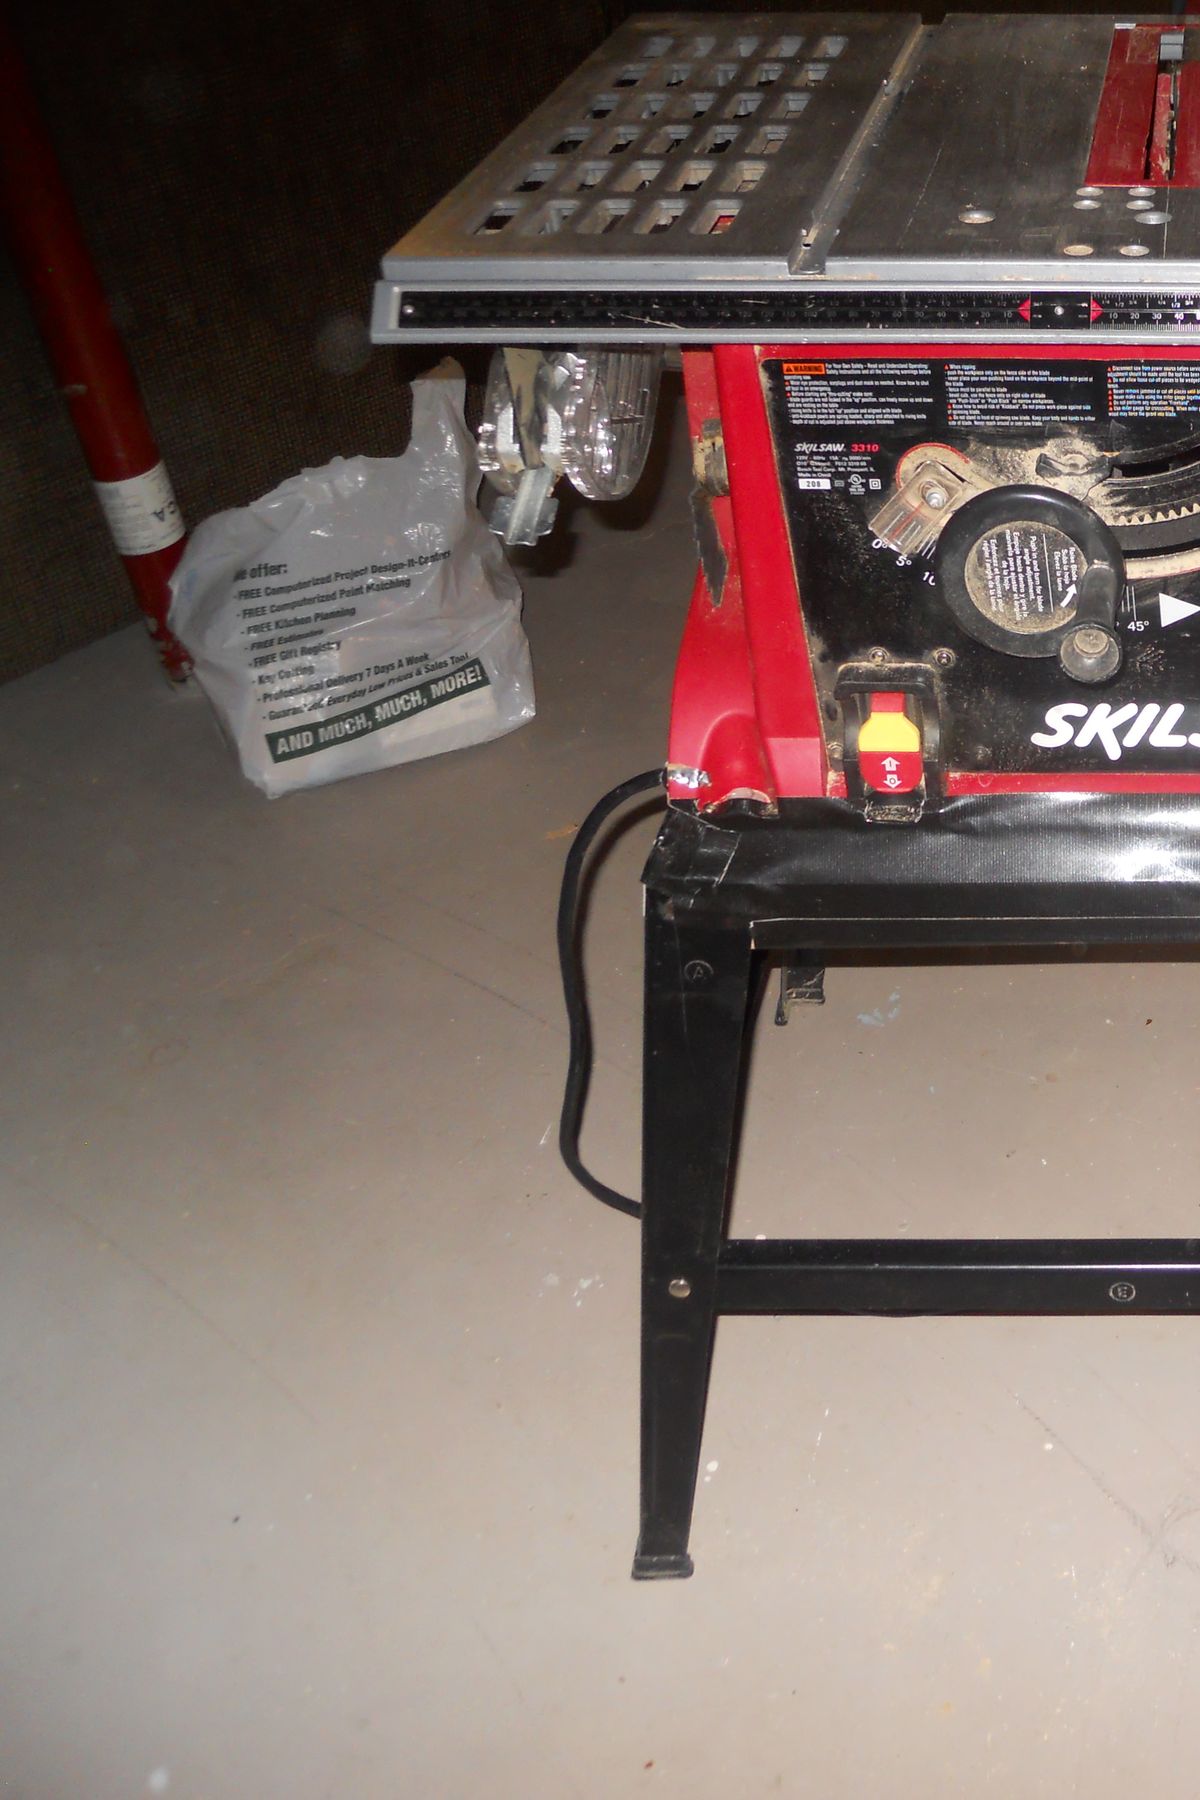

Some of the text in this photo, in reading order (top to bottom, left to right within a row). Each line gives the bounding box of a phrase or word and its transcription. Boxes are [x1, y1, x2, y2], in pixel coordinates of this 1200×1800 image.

[793, 365, 823, 373] WARNING
[794, 442, 879, 454] SKILSAW 3310
[806, 480, 821, 488] 208
[1013, 532, 1021, 556] Empuje
[1018, 573, 1026, 593] dentro
[1054, 551, 1062, 570] Elevez
[1061, 548, 1069, 565] Suba
[1069, 547, 1078, 581] Raise Blade
[239, 587, 262, 600] FREE
[264, 573, 332, 596] Computerized
[334, 567, 369, 582] Project
[249, 563, 287, 579] offer:
[1023, 548, 1035, 601] angle adjustment.
[1063, 571, 1071, 585] hoja
[243, 578, 411, 619] FREE Computerized Paint Matching
[995, 574, 1003, 598] tournez
[1032, 560, 1040, 572] and
[1036, 595, 1044, 612] blade
[247, 606, 356, 635] FREE Kitchen Planning
[251, 638, 275, 650] FREE
[253, 640, 342, 668] FREE Gift Registry
[258, 664, 315, 685] Key Cutting
[263, 682, 324, 703] Professional
[327, 671, 364, 688] Delivery
[374, 662, 395, 676] Days
[397, 659, 404, 669] A
[405, 652, 429, 666] Week
[368, 682, 386, 694] Low
[388, 672, 414, 686] Prices
[425, 660, 449, 674] Sales
[277, 664, 482, 754] AND MUCH, MUCH, MORE!
